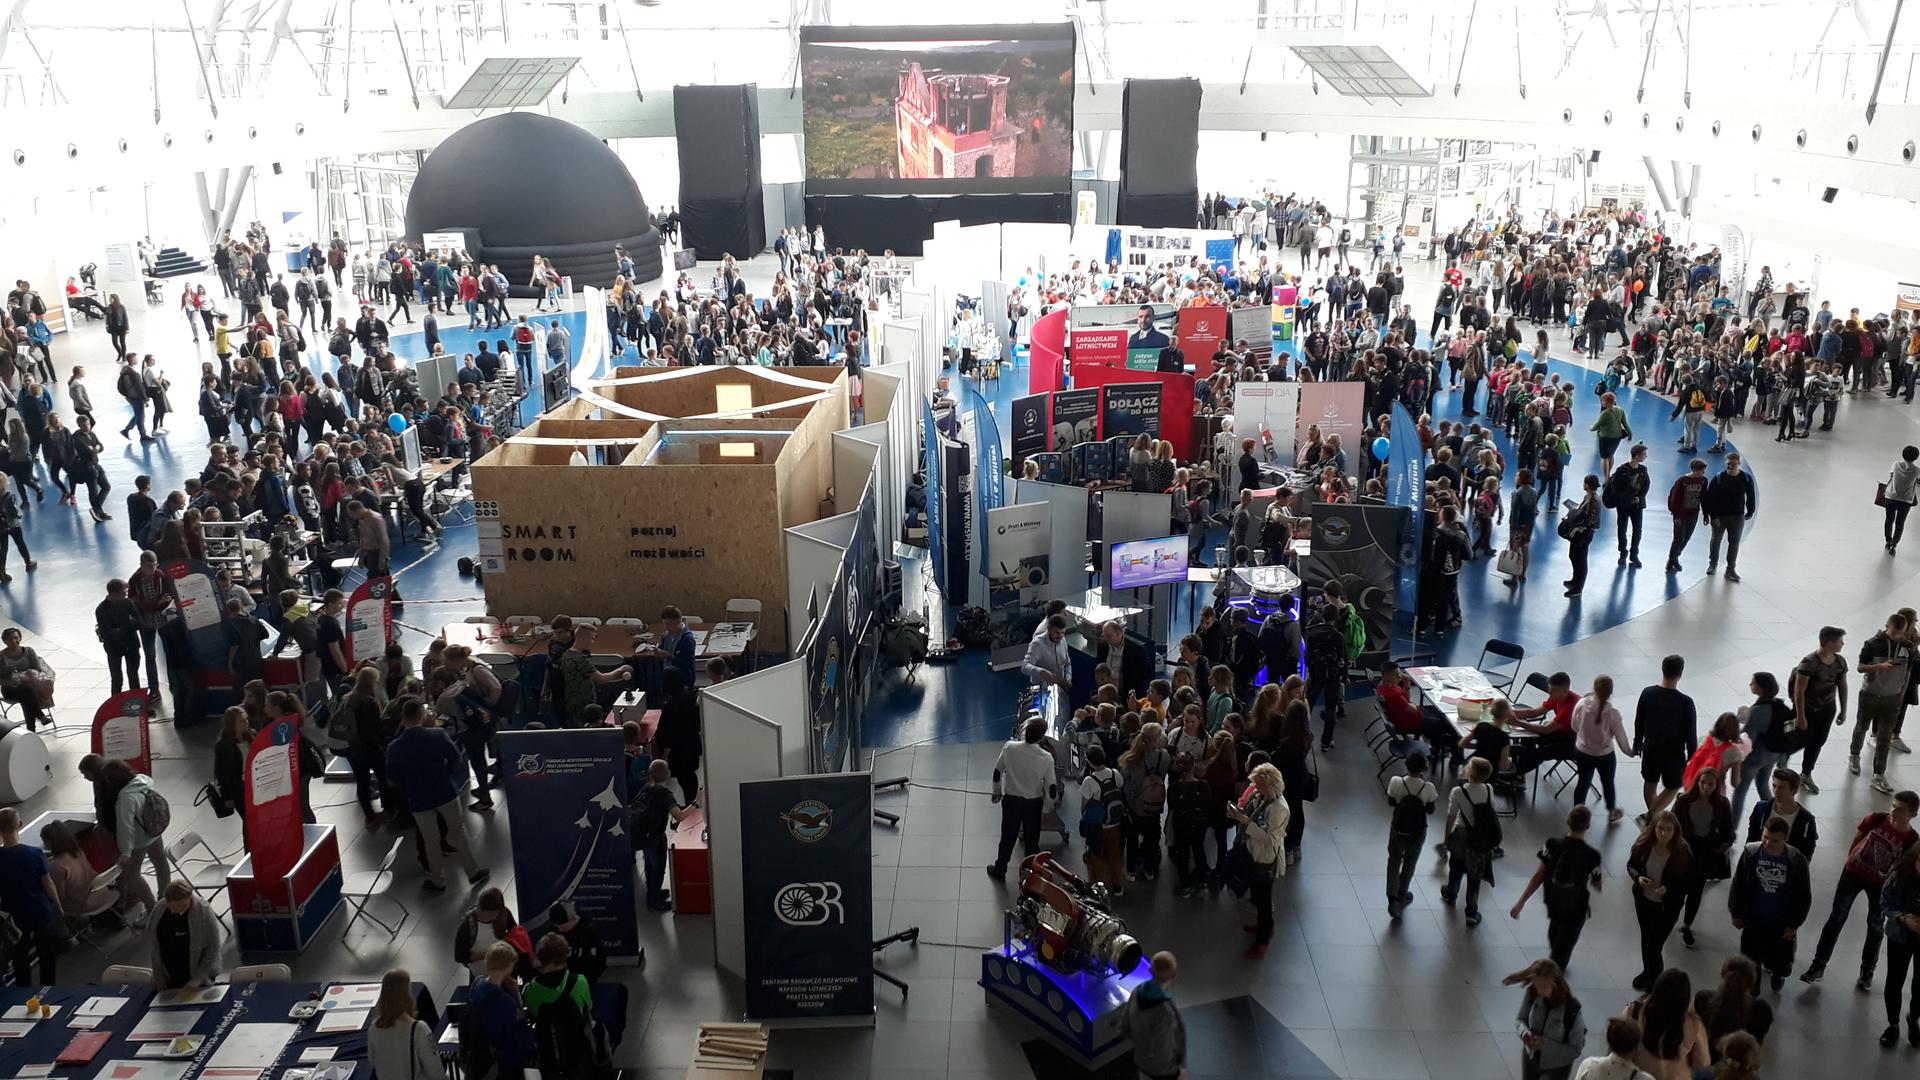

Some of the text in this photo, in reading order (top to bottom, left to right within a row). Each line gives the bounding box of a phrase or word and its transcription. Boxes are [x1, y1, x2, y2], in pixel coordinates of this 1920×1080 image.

[1075, 335, 1118, 343] ZARZĄDZANIE
[1075, 342, 1117, 350] LOTNICTWEM
[1109, 397, 1158, 409] DOŁĄCZ
[503, 525, 577, 539] SMART
[631, 525, 677, 537] poznaj
[963, 494, 971, 560] WWW.WSPIA.EU
[508, 547, 574, 561] ROOM
[630, 547, 705, 559] możliwości
